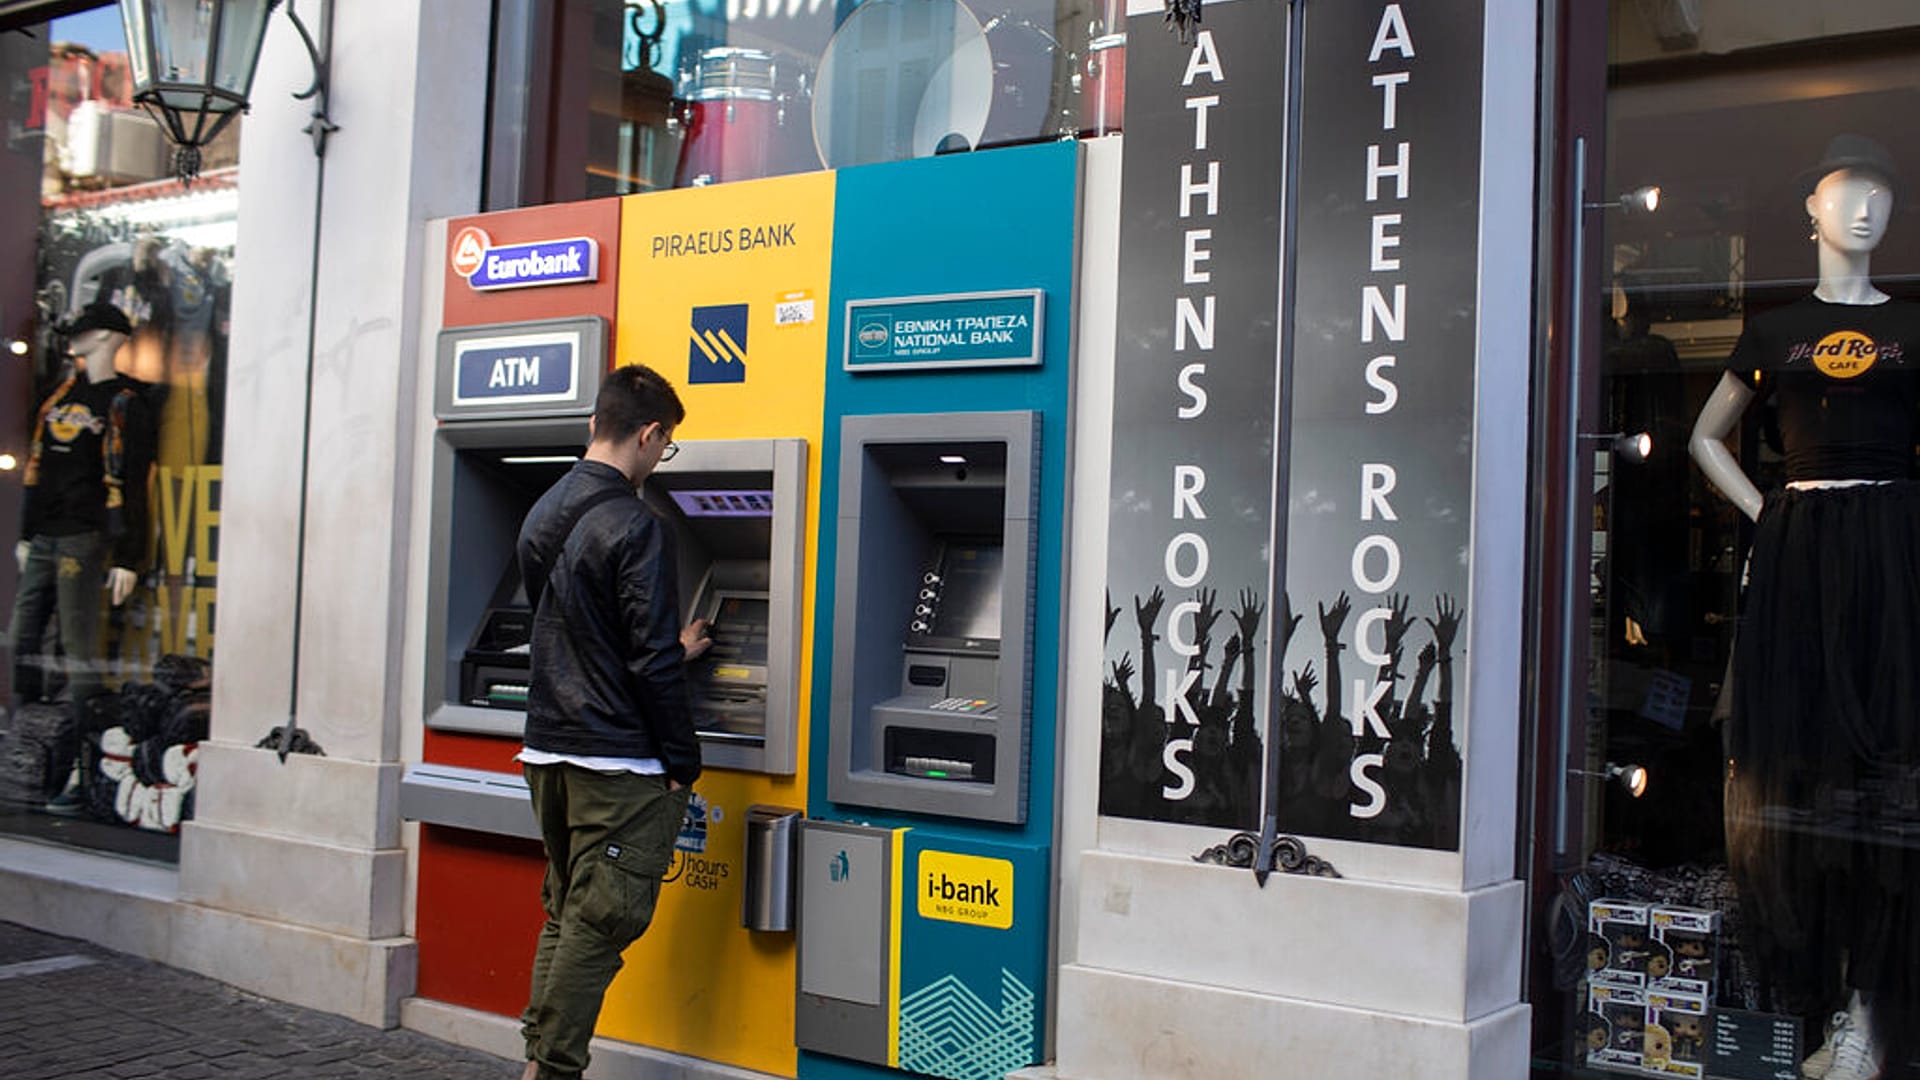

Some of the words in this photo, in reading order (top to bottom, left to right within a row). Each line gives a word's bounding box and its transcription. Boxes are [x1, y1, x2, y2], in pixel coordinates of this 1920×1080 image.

[1173, 30, 1225, 419] ATHENS
[1361, 3, 1415, 415] ATHENS
[652, 229, 733, 258] PIRAEUS
[739, 222, 797, 251] BANK
[487, 246, 582, 280] Eurobank
[894, 332, 967, 348] NATIONAL
[970, 330, 1014, 345] BANK
[488, 356, 541, 389] ATM
[1828, 362, 1859, 371] CAFE
[150, 465, 222, 576] VE
[1162, 465, 1209, 800] ROCKS
[1350, 463, 1401, 819] ROCKS
[686, 853, 729, 878] hours
[686, 873, 718, 890] CASH
[928, 872, 999, 907] i-bank
[957, 907, 989, 918] GROUP
